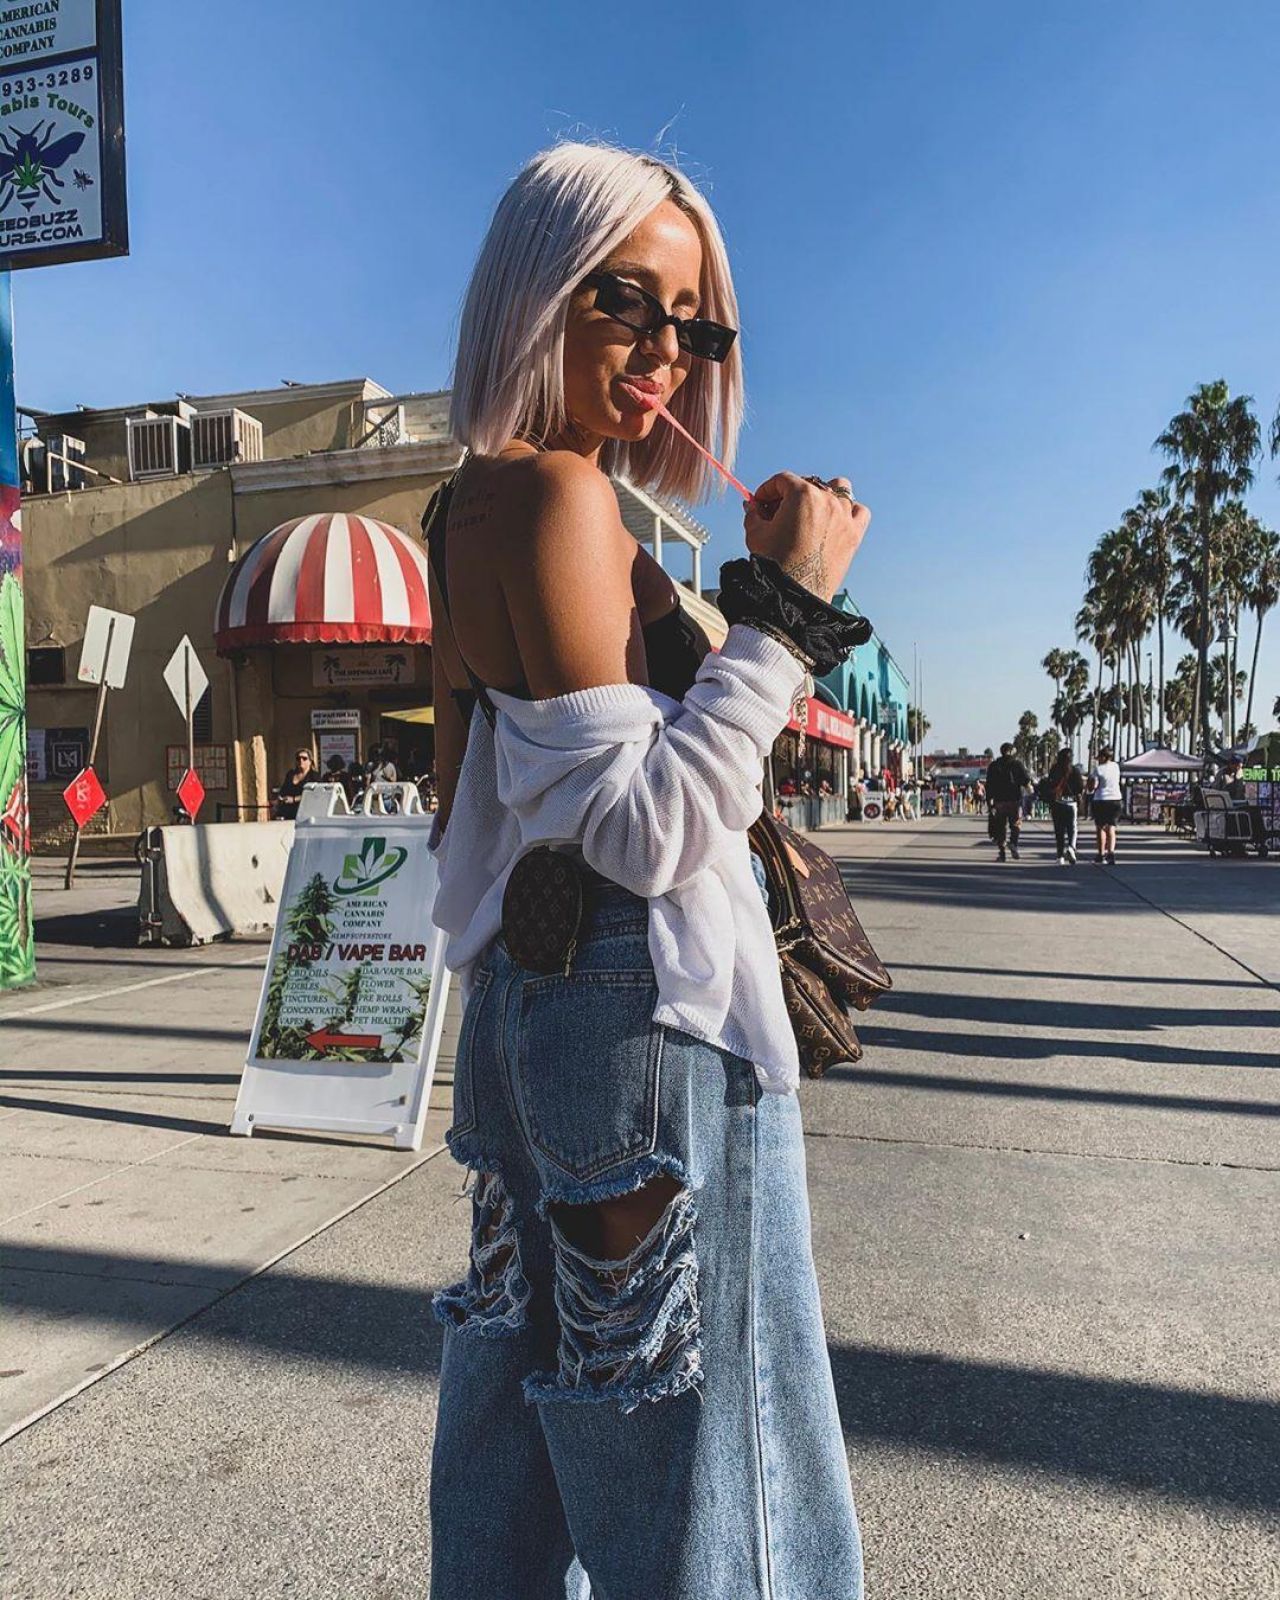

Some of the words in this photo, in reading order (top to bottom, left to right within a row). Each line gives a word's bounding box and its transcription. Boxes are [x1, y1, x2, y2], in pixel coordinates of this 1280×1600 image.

[2, 65, 94, 97] 933-3289
[46, 92, 95, 128] Tours
[1243, 768, 1268, 781] ENNA
[346, 900, 388, 908] AMERICAN
[344, 909, 385, 918] CANNABIS
[342, 919, 382, 928] COMPANY
[287, 943, 322, 961] DAB
[338, 943, 385, 961] VAPE
[388, 943, 427, 961] BAR
[288, 968, 306, 978] CBD
[308, 968, 329, 978] OILS
[406, 966, 423, 976] BAR
[286, 981, 320, 990] EDIBLES
[360, 980, 395, 989] FLOWER
[284, 994, 328, 1003] TINCTURES
[377, 993, 403, 1002] ROLLS
[281, 1006, 345, 1015] CONCENTRATES
[355, 1005, 379, 1014] HEMP
[382, 1005, 411, 1014] WRAPS
